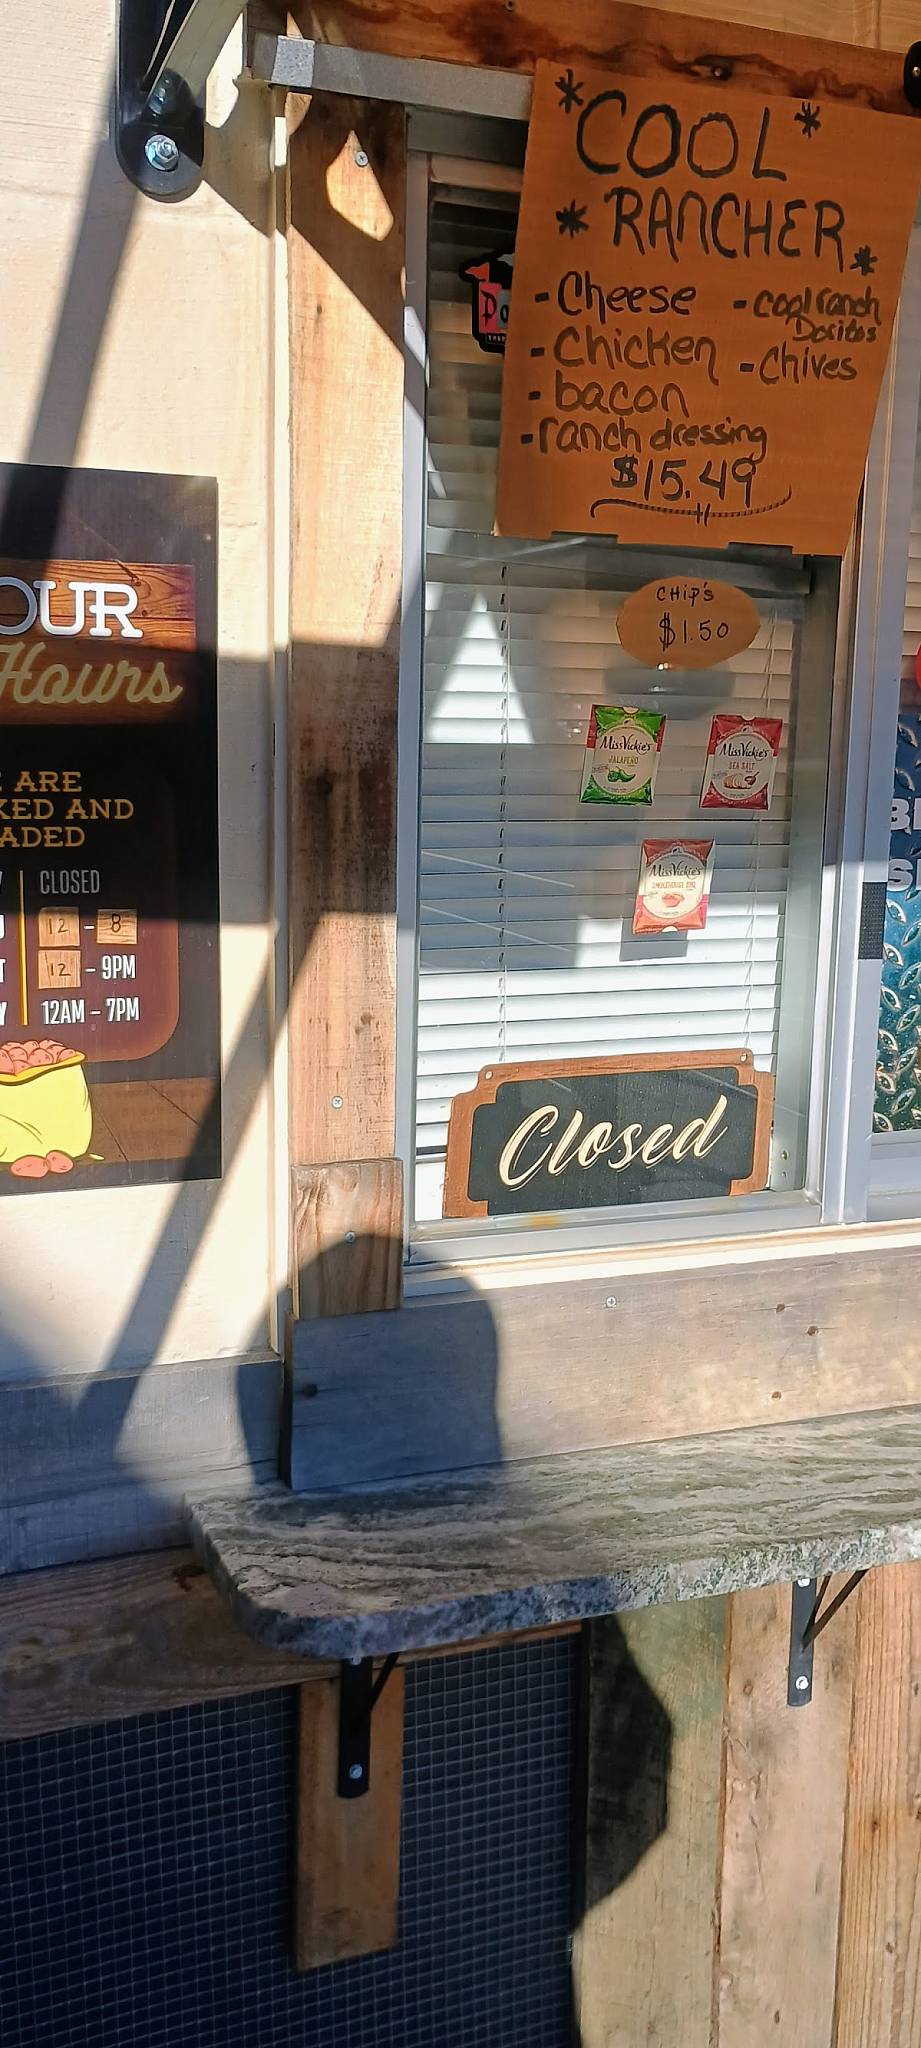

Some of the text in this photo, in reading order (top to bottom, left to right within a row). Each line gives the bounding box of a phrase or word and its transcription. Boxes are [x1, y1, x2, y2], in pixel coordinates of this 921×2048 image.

[576, 89, 787, 181] COOL
[604, 186, 846, 272] RANCHER
[650, 416, 767, 464] dressing
[611, 453, 757, 508] $15.49
[0, 576, 144, 638] OUR
[659, 611, 729, 652] $1.50
[0, 641, 184, 704] Hours
[14, 771, 82, 792] ARE
[65, 799, 134, 820] AND
[40, 870, 100, 894] CLOSED
[48, 918, 69, 934] 12
[111, 913, 121, 933] 8
[50, 963, 71, 977] 12
[101, 954, 137, 980] 9PM
[41, 999, 85, 1025] 12AM
[105, 997, 140, 1023] 7PM
[498, 1094, 728, 1191] Closed
